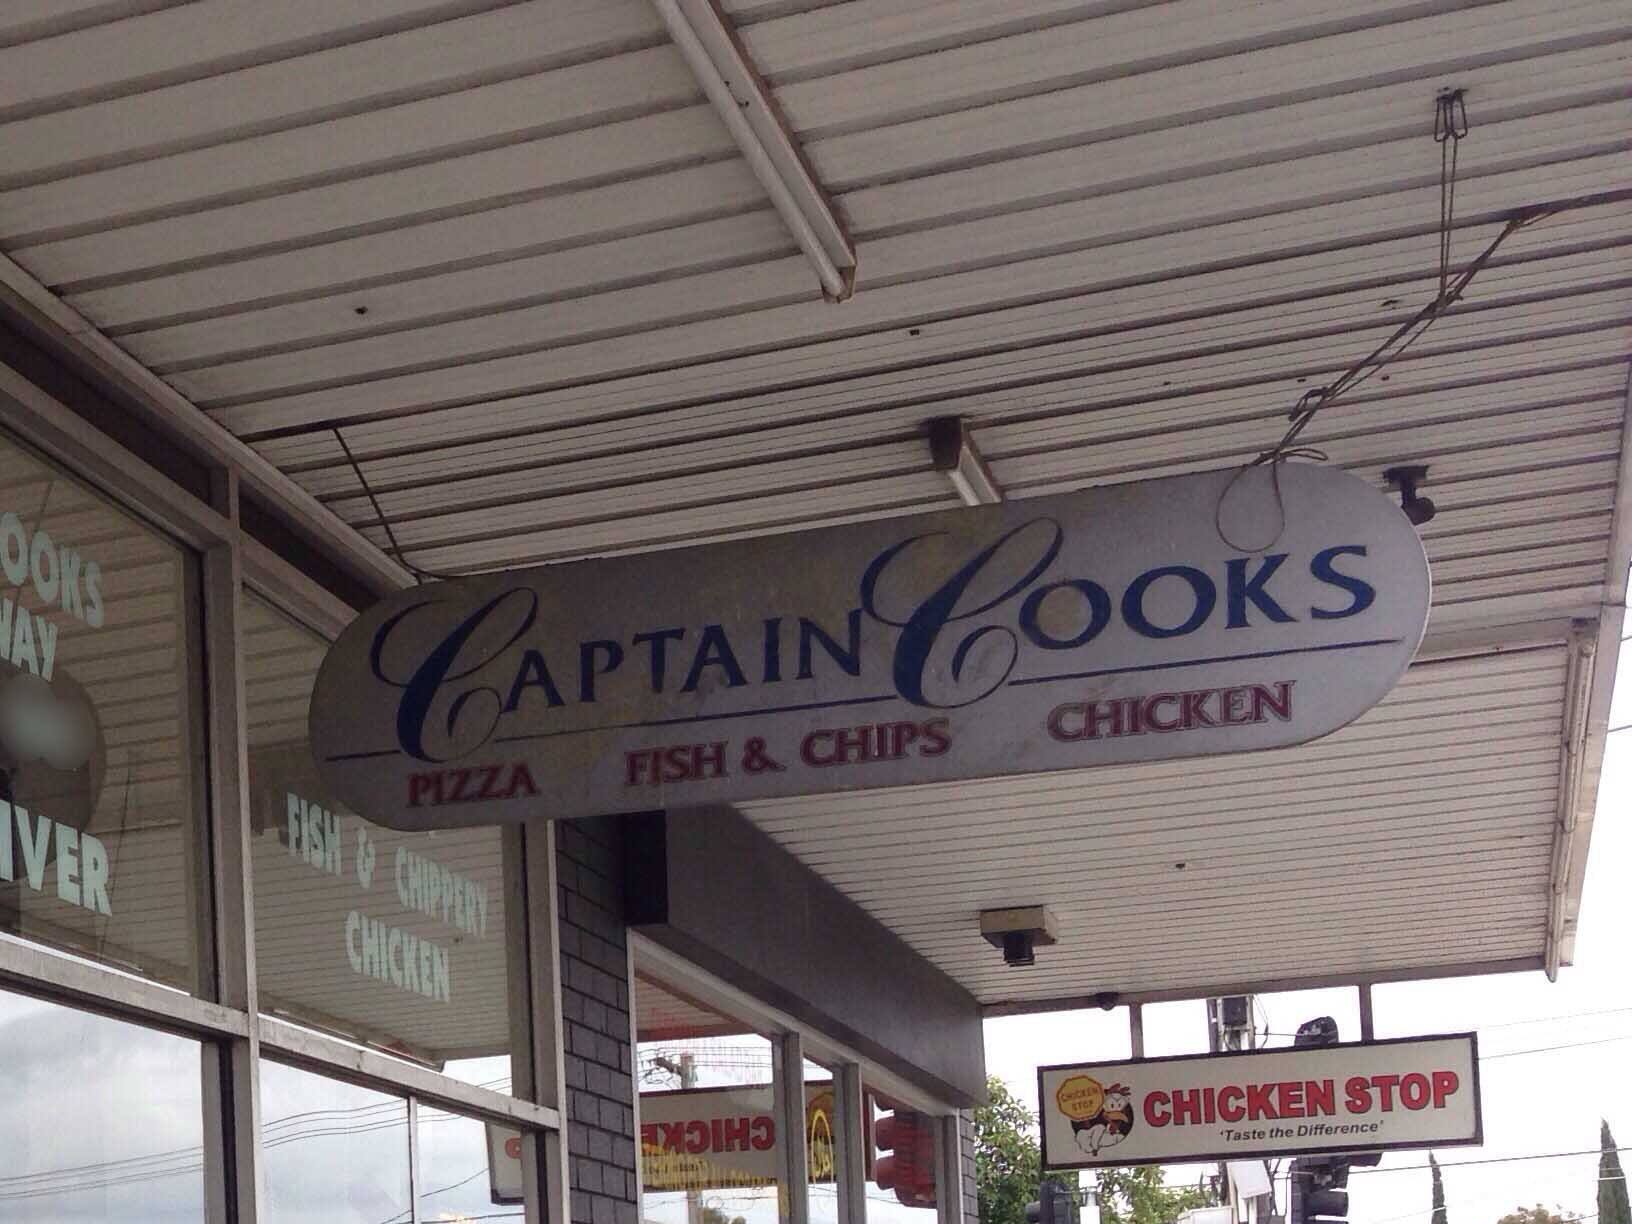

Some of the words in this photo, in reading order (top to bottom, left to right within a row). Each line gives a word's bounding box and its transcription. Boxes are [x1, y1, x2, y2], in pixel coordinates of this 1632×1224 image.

[371, 587, 863, 762] CAPTAIN
[860, 515, 1376, 709] COOKS
[406, 762, 540, 807] PIZZA
[624, 743, 726, 788] FISH
[742, 737, 786, 774] &
[799, 718, 951, 769] CHIPS
[1046, 678, 1298, 745] CHICKEN
[287, 792, 342, 876] FISH
[345, 910, 450, 1003] CHICKEN
[1143, 1079, 1335, 1128] CHICKEN
[1345, 1071, 1459, 1115] STOP
[1269, 1126, 1295, 1139] the
